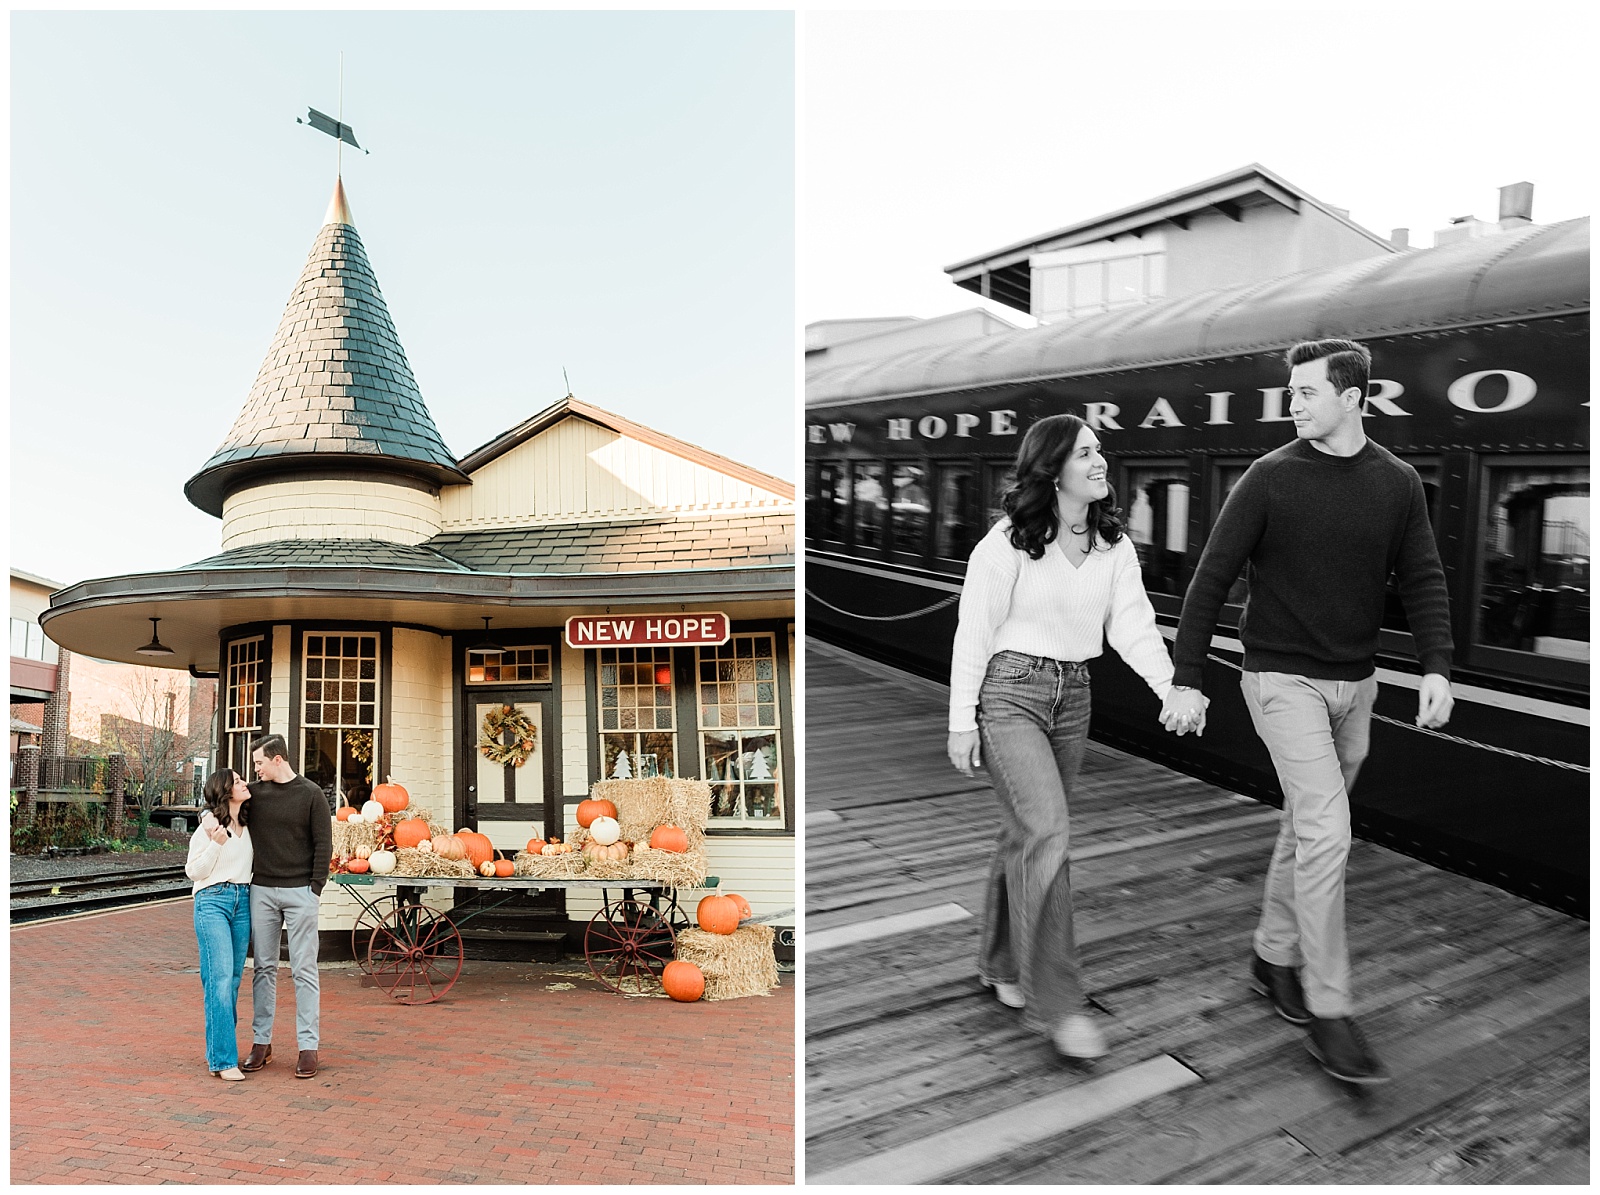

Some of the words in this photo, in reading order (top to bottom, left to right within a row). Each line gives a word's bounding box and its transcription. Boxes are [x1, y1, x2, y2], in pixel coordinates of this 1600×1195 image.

[806, 422, 857, 444] EW
[886, 408, 1018, 441] HOPE
[1082, 368, 1590, 430] RAILRO
[577, 619, 635, 642] NEW
[646, 617, 717, 640] HOPE
